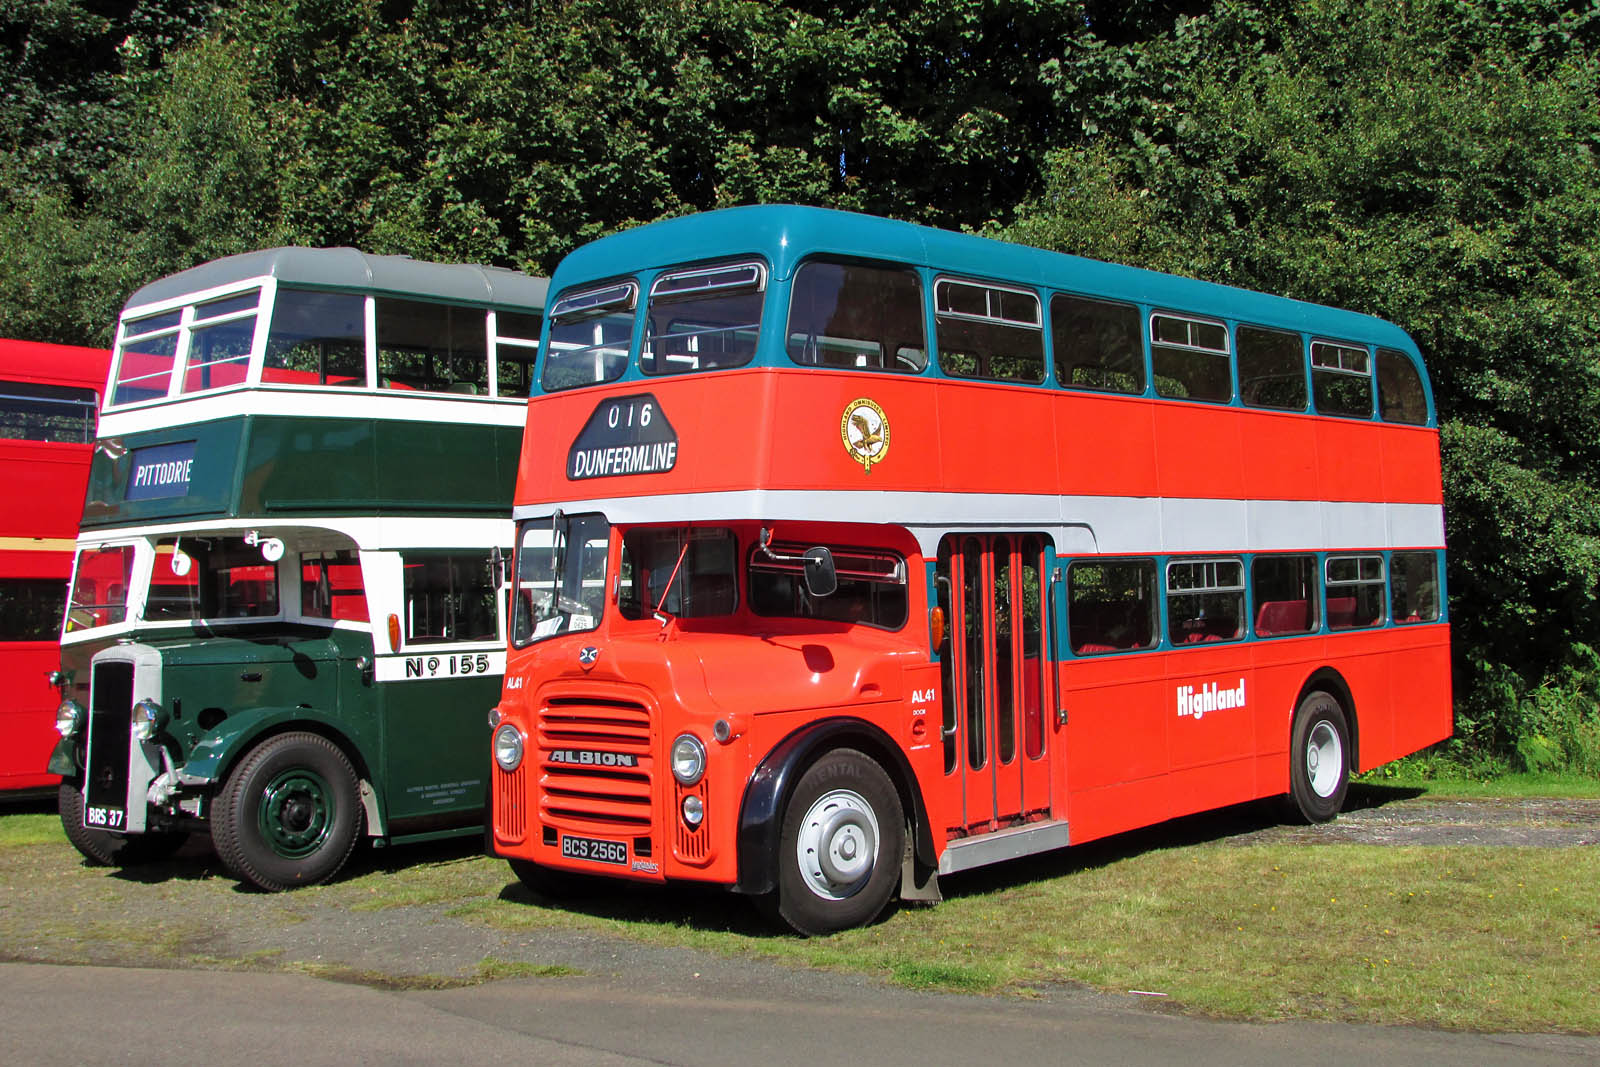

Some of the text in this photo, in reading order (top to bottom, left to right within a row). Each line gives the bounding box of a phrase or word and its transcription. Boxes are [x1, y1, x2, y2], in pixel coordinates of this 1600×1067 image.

[608, 403, 652, 428] 016
[854, 399, 881, 414] OMNIBUSES
[574, 442, 676, 477] DUNFERMLINE
[134, 459, 193, 487] PITTODRIE
[450, 654, 490, 675] 155
[507, 677, 523, 689] AL41
[911, 688, 935, 704] AL41
[1177, 678, 1245, 720] Highland
[551, 750, 632, 767] ALBION
[88, 807, 123, 826] BRS 37
[563, 838, 625, 861] BCS 256C
